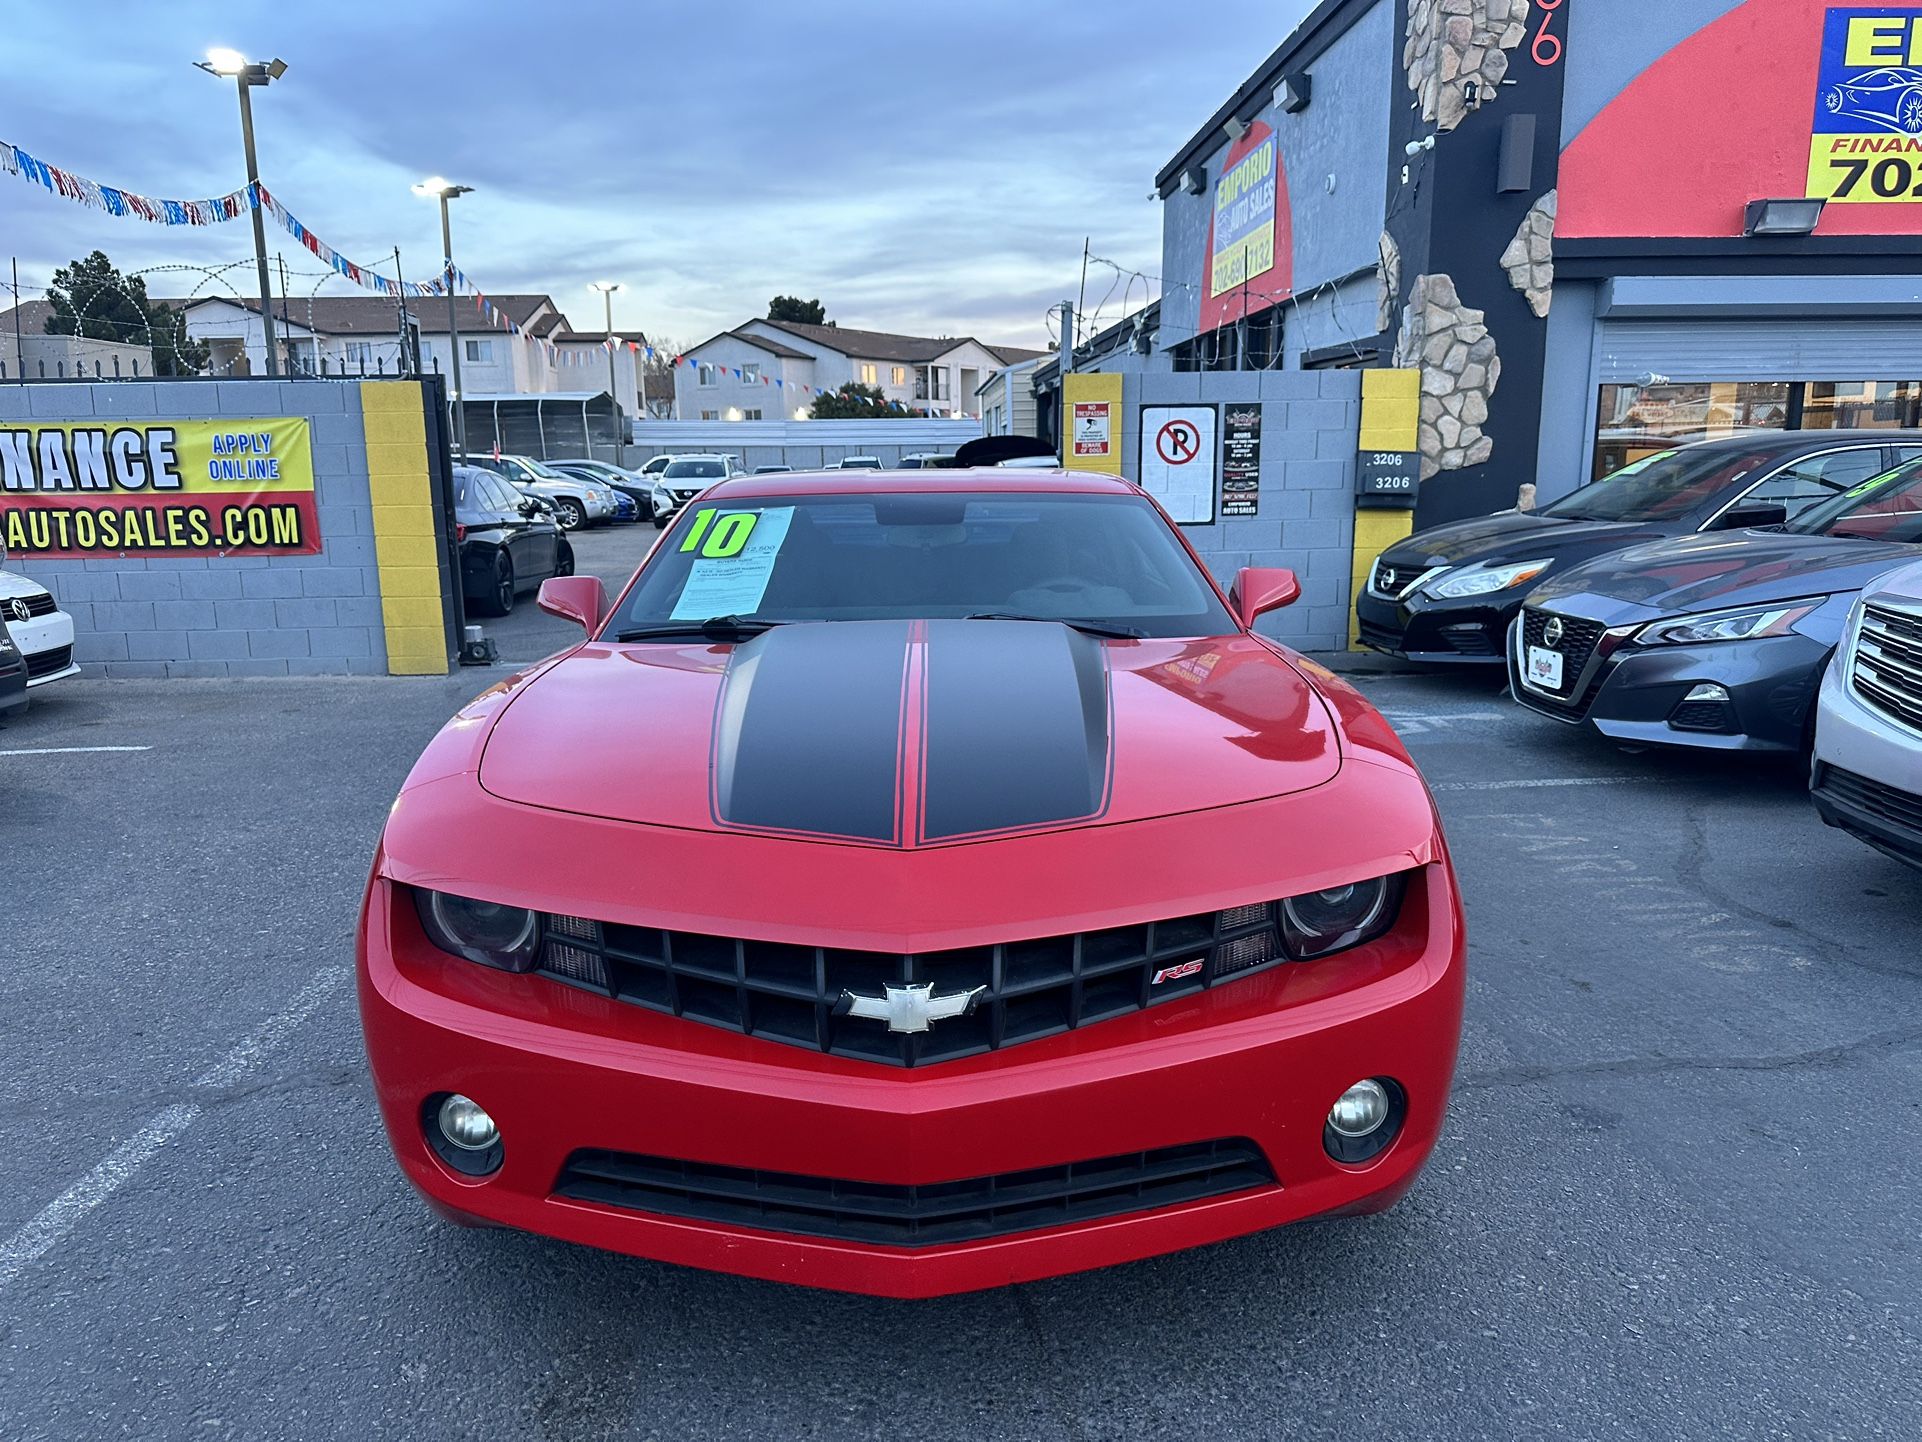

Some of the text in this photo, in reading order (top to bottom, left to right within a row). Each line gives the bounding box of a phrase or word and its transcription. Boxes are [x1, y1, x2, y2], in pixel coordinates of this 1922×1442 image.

[1217, 141, 1272, 212] EMPORIO
[1231, 178, 1274, 231] AUTO SALES
[212, 432, 272, 454] APPLY
[208, 457, 280, 480] ONLINE
[1373, 453, 1403, 466] 3206
[1375, 476, 1410, 489] 3206
[1239, 506, 1257, 514] SALES
[6, 506, 300, 549] AUTOSALES.COM
[679, 508, 757, 558] 10
[1151, 958, 1205, 985] RS
